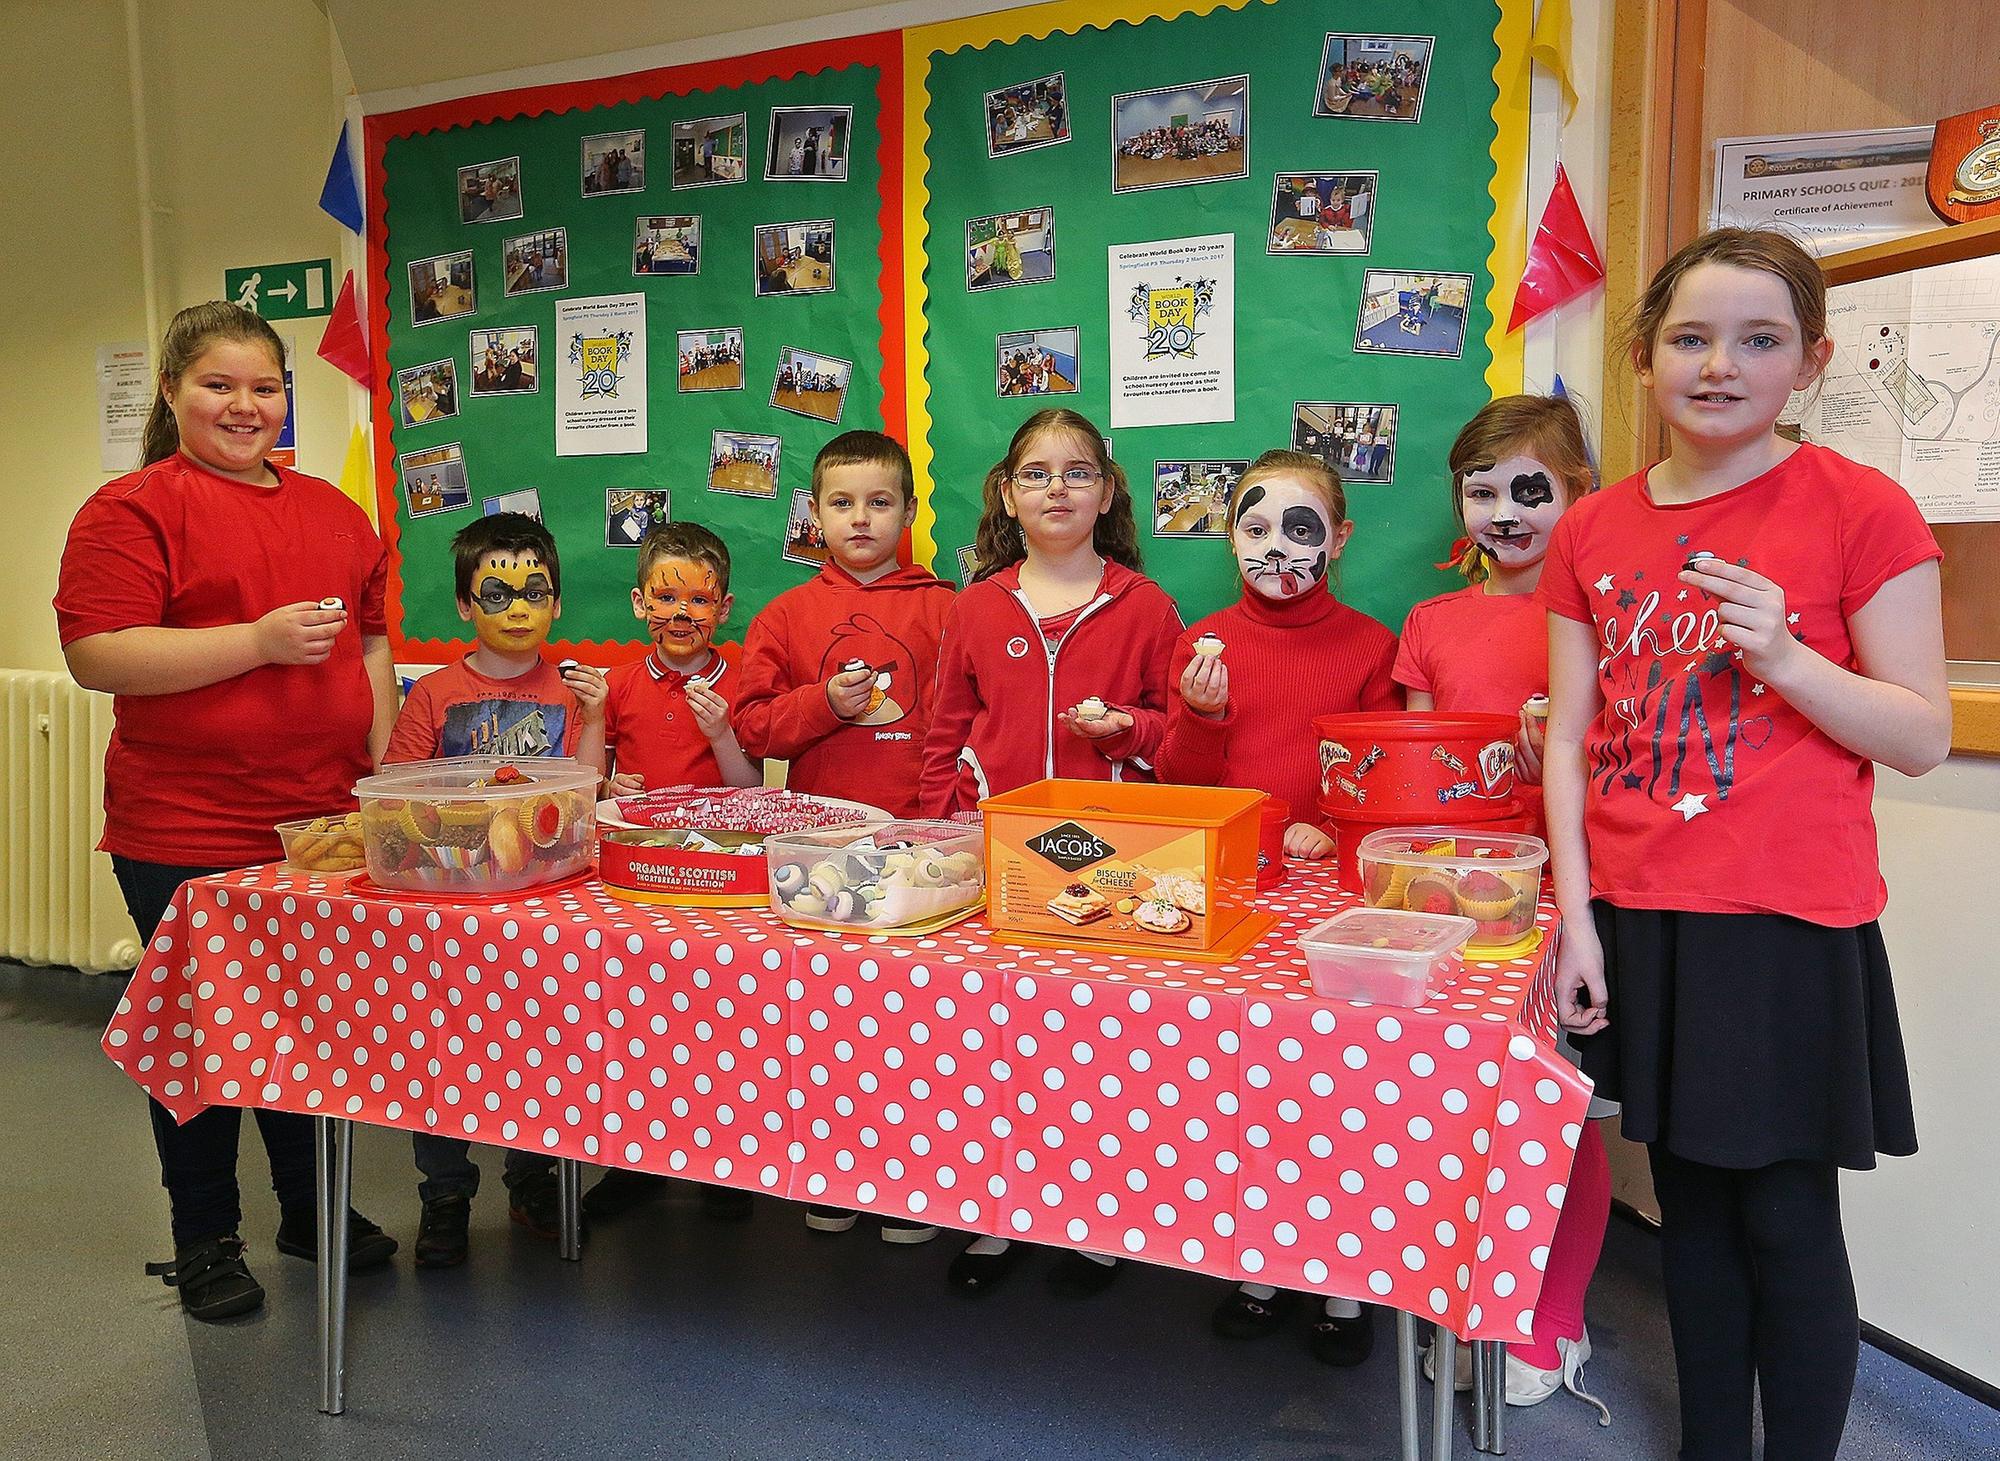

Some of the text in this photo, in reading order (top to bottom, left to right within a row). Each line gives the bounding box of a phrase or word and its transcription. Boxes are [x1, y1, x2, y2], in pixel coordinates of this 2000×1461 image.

[1743, 187, 1798, 202] PRIMARY
[1800, 182, 1856, 197] SCHOOLS
[1859, 179, 1891, 192] QUIZ
[1900, 175, 1923, 187] 201
[1774, 199, 1893, 217] Certificate of Achievement
[1119, 251, 1148, 259] Celebrate
[1159, 258, 1185, 266] Thursday
[1155, 298, 1188, 309] BOOK
[1160, 308, 1182, 318] DAY
[1148, 325, 1193, 354] 20
[587, 346, 613, 355] BOOK
[591, 355, 608, 363] DAY
[583, 369, 616, 394] 20
[875, 731, 912, 741] ANGRY BIRDS
[1038, 836, 1104, 858] JACOB'S
[629, 861, 736, 881] ORGANIC SCOTTISH
[1096, 869, 1137, 880] BISCUITS
[636, 873, 725, 888] SHORTBREAD SELECTION
[1099, 877, 1134, 888] CHEESE
